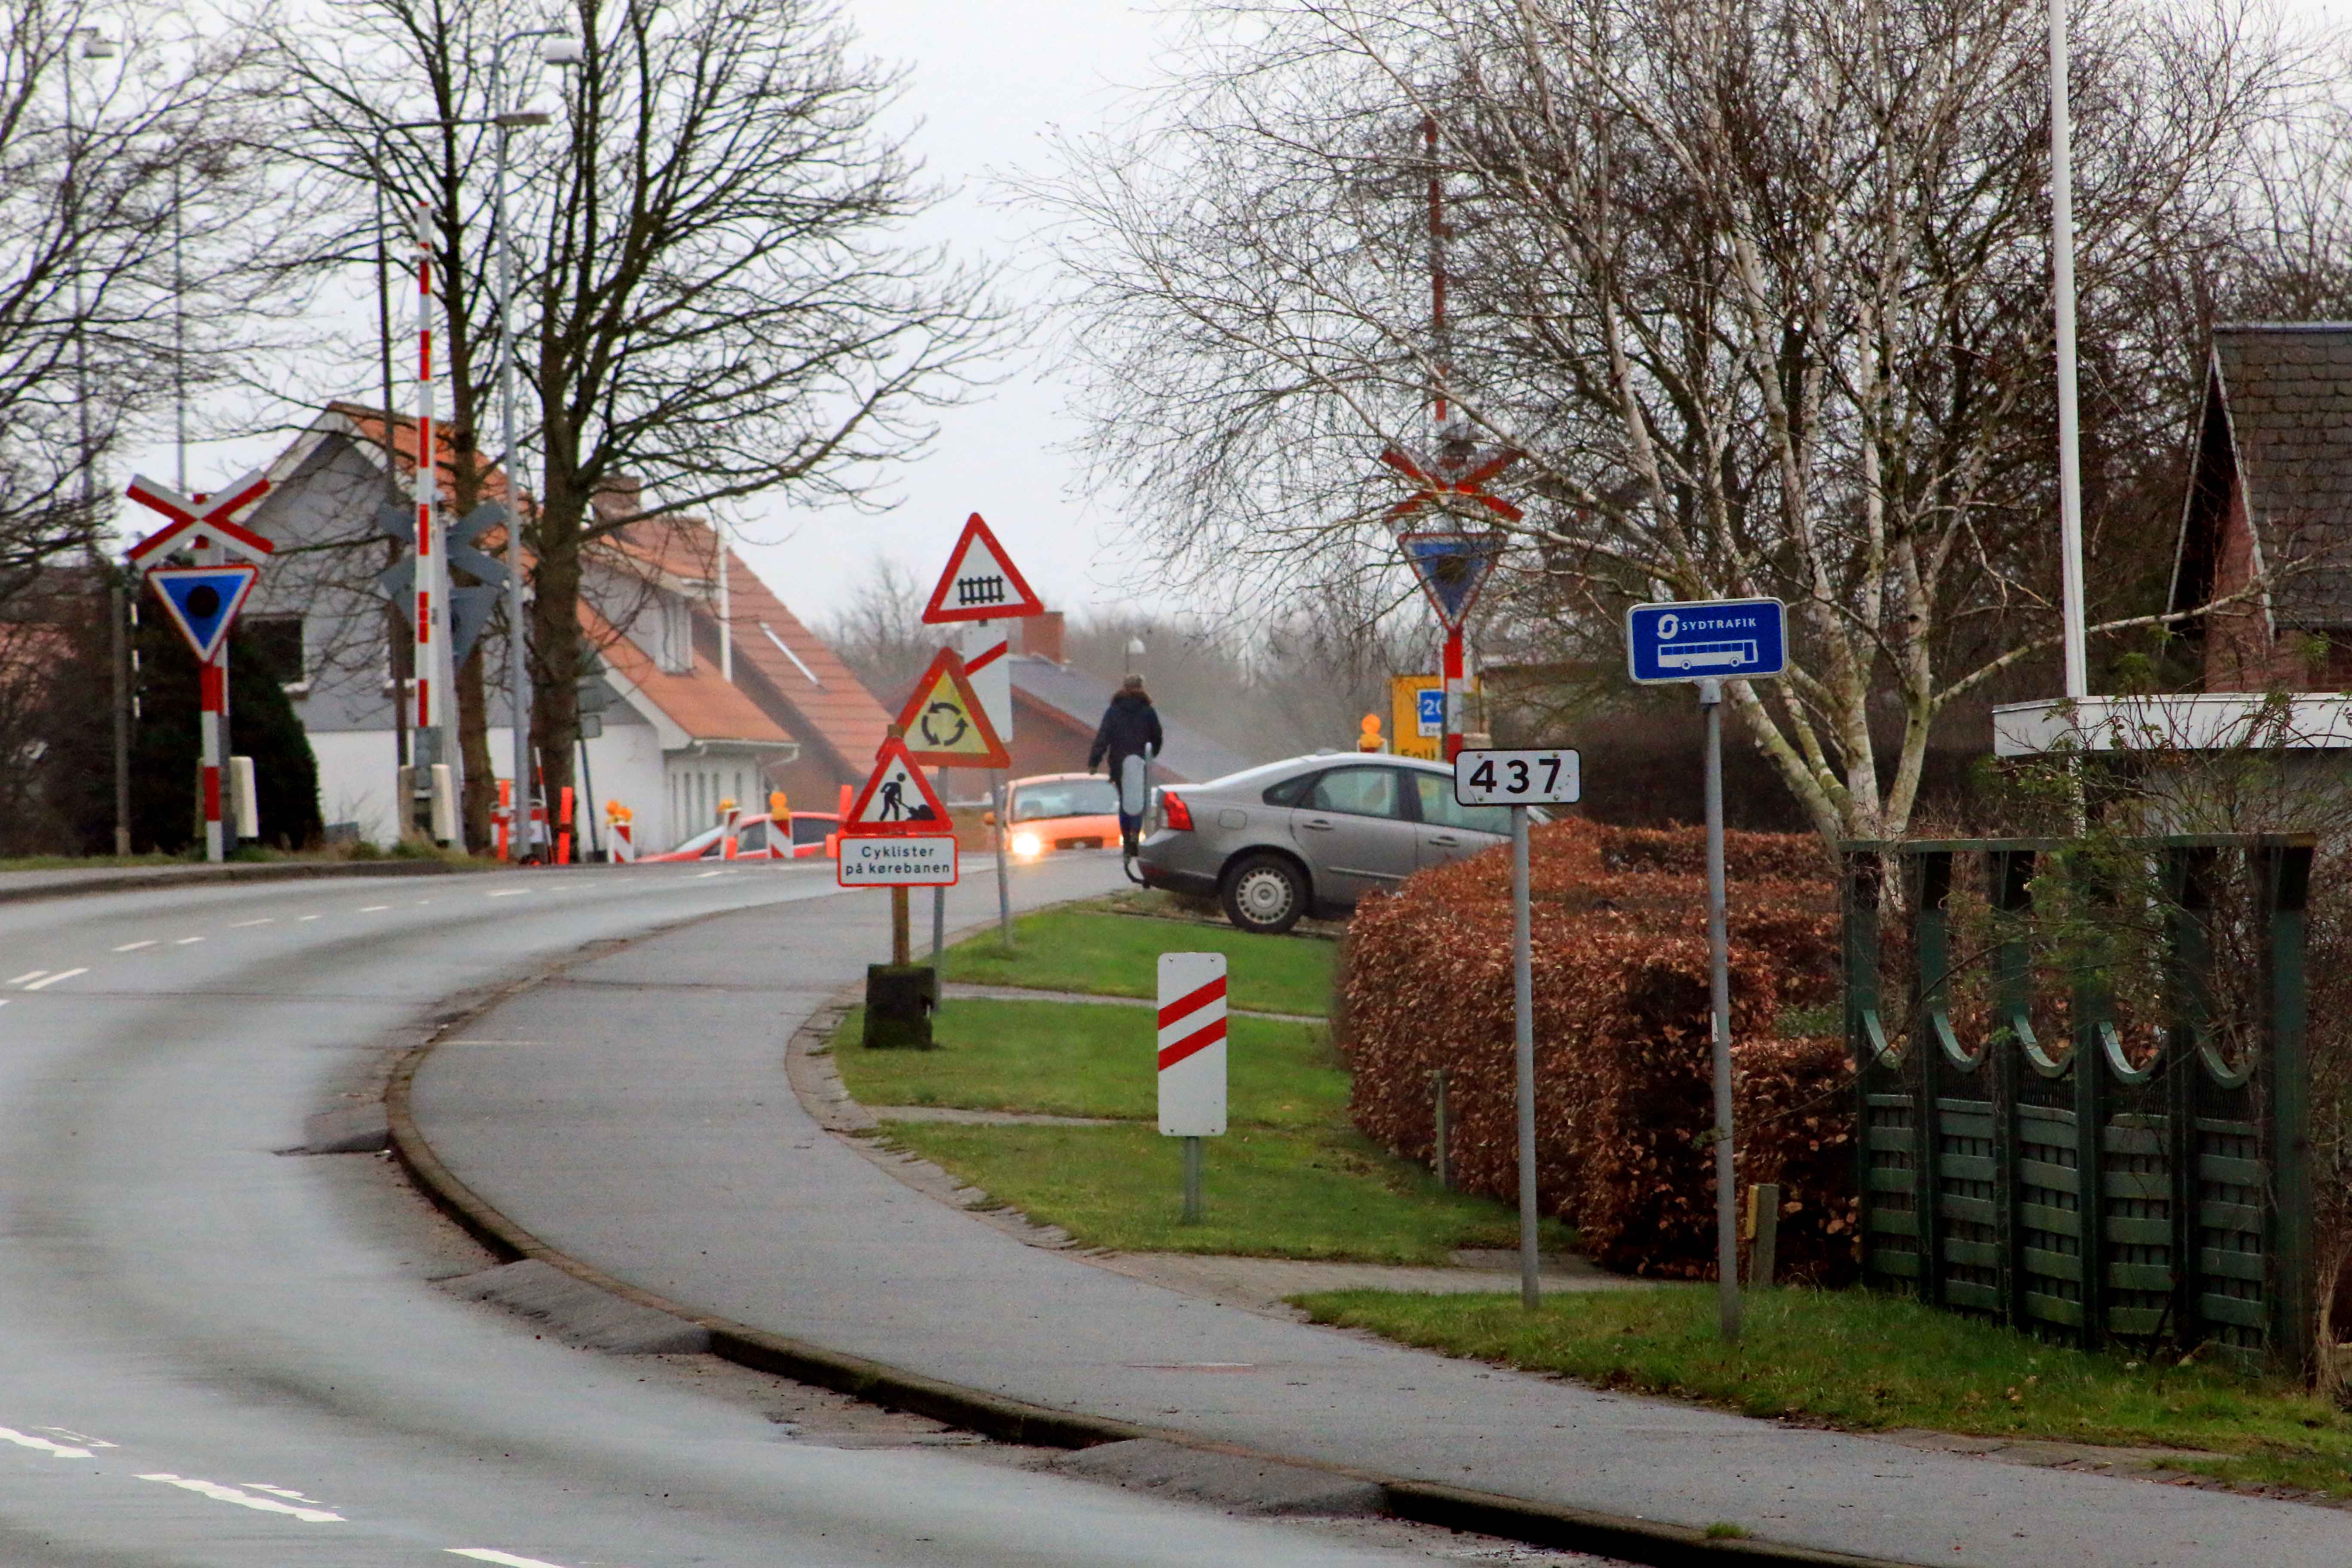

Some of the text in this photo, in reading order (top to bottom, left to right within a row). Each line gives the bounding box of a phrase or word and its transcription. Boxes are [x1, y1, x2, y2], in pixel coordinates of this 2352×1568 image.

[1681, 617, 1757, 631] SYDTRAFIK
[1469, 758, 1562, 794] 437
[861, 846, 935, 859] Cyklister
[845, 862, 950, 876] på kørebanen
